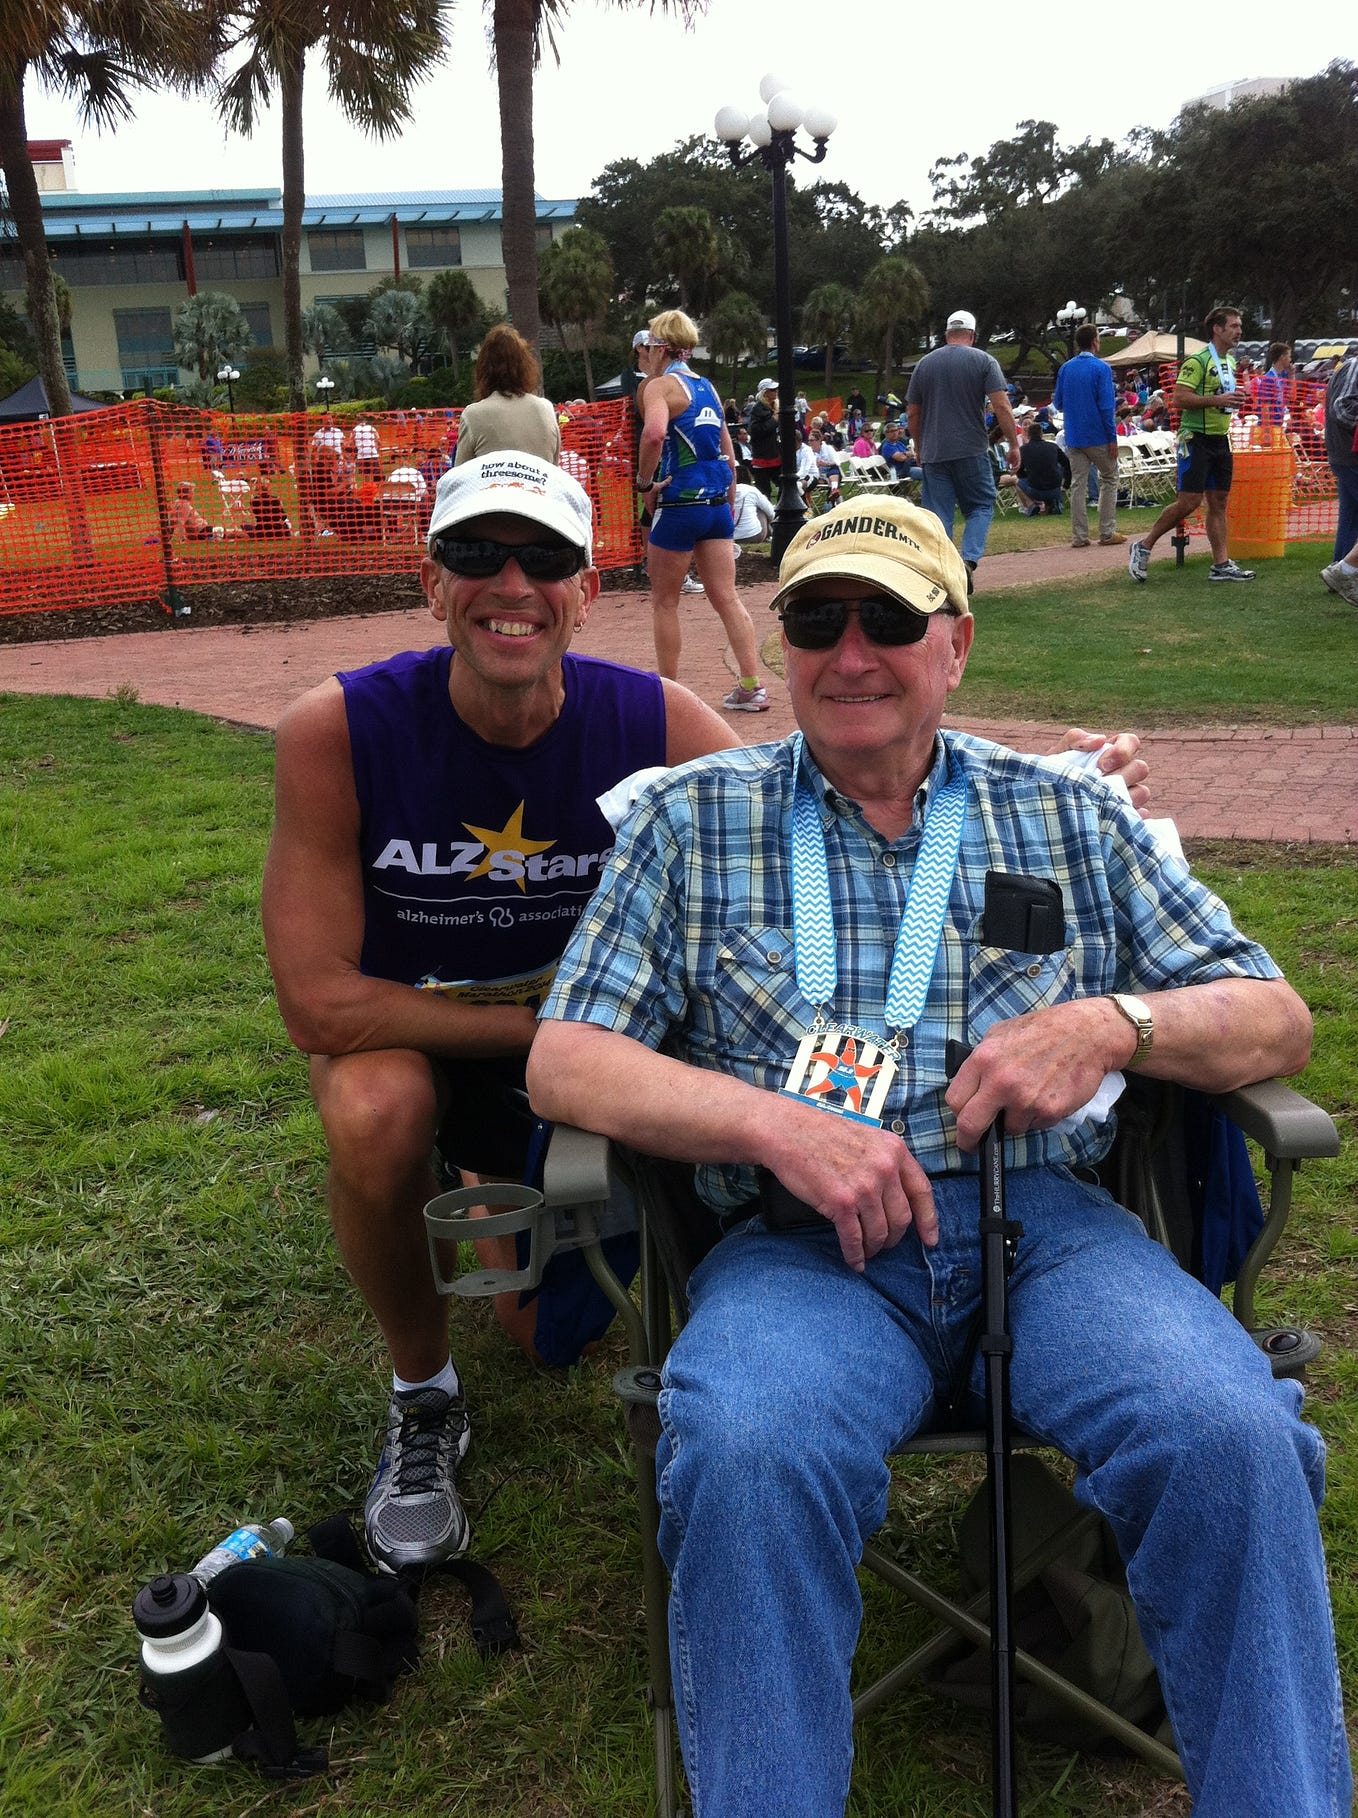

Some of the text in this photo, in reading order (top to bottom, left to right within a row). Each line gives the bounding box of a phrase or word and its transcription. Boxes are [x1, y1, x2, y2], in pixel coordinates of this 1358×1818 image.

[481, 462, 505, 470] how
[508, 461, 540, 475] about
[481, 470, 546, 486] threesome?
[820, 516, 898, 541] GANDER
[397, 904, 584, 926] alzheimer's associati
[806, 1022, 902, 1063] CLEARWATER
